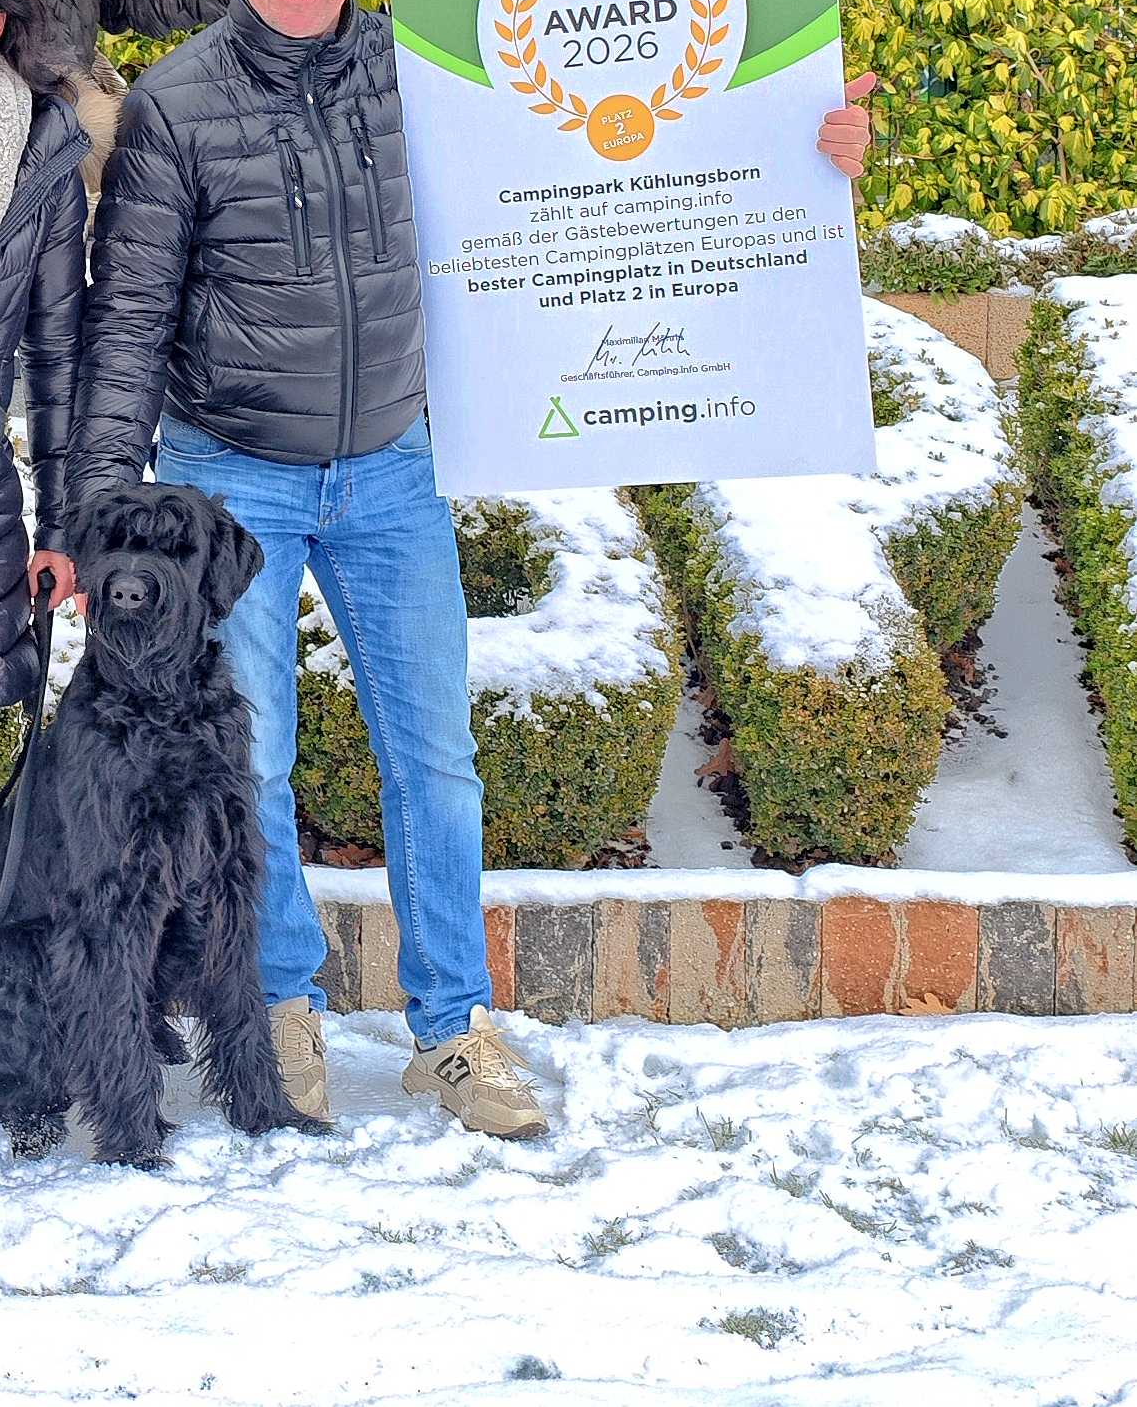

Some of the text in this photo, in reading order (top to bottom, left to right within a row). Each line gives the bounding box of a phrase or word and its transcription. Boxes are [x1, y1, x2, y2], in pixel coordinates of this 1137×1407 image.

[563, 31, 659, 68] 2026
[601, 109, 633, 125] PLATZ
[614, 122, 626, 135] 2
[602, 132, 645, 150] EUROPA
[499, 167, 760, 203] Campingpark Kühlungsborn
[530, 191, 732, 223] zählt auf camping.info
[461, 206, 807, 253] gemäß der Gästebewertungen zu den
[429, 225, 845, 275] beliebtesten Campingplätzen Europas und ist
[468, 249, 808, 293] bester Campingplatz in Deutschland
[539, 282, 738, 308] und Platz 2 in Europa
[637, 365, 698, 377] Camping.info
[702, 363, 731, 373] GmbH
[584, 396, 756, 426] camping.info
